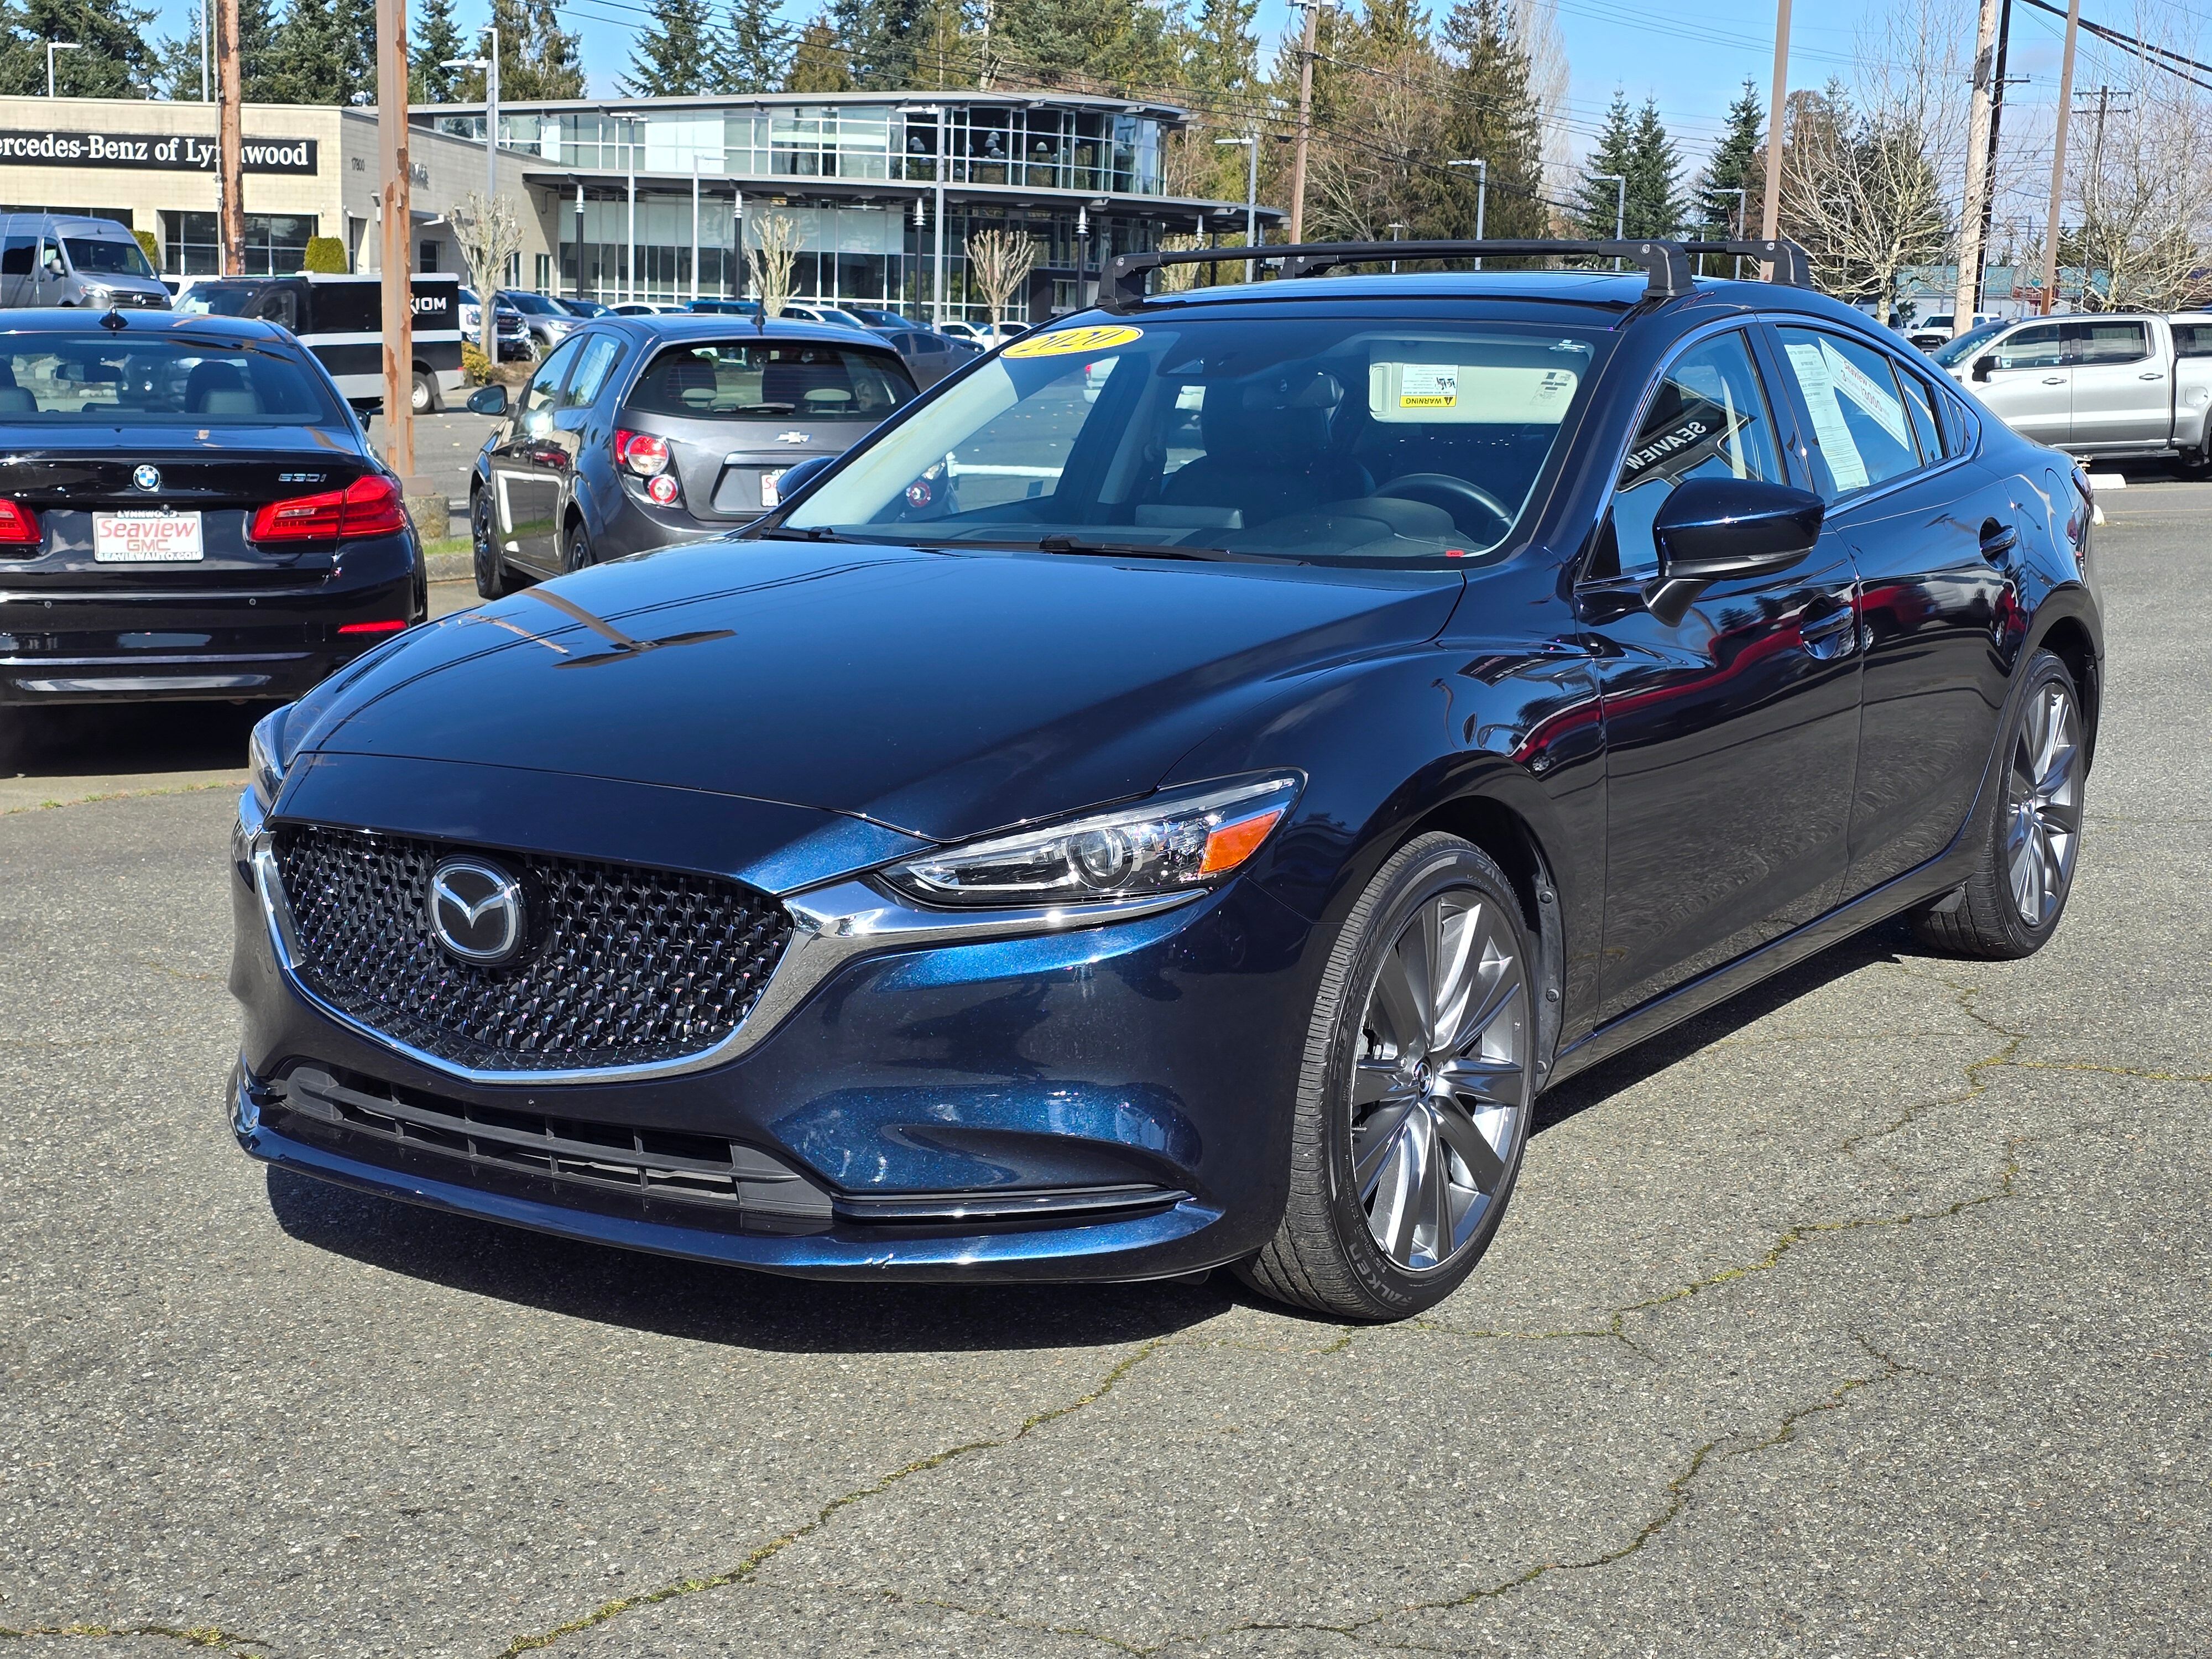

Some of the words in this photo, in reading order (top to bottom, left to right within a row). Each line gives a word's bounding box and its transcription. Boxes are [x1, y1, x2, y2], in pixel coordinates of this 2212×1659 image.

[0, 134, 148, 160] rcedes-Benz
[155, 138, 179, 161] of
[186, 138, 308, 168] Lywood
[1013, 330, 1126, 353] 2020
[100, 519, 196, 538] Seaview
[127, 539, 171, 552] GMC
[96, 551, 202, 561] SEAVIEWAUTO.COM
